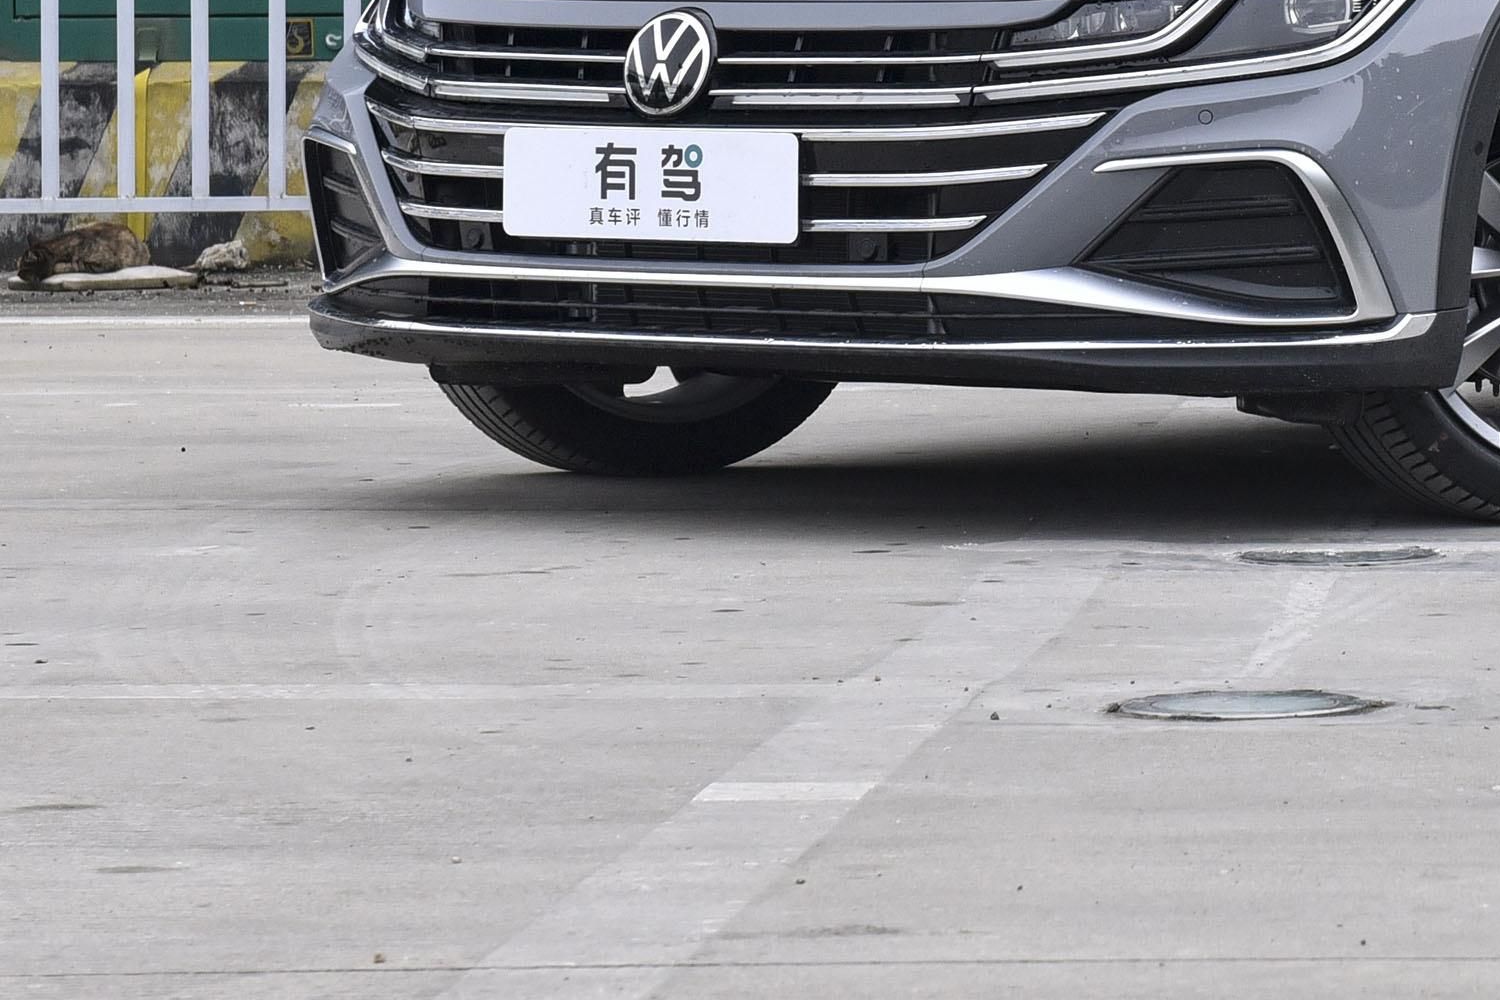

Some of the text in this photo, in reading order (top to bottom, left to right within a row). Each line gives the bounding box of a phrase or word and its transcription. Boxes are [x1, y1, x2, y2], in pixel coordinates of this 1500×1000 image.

[589, 207, 709, 228] 真车评 懂行情
